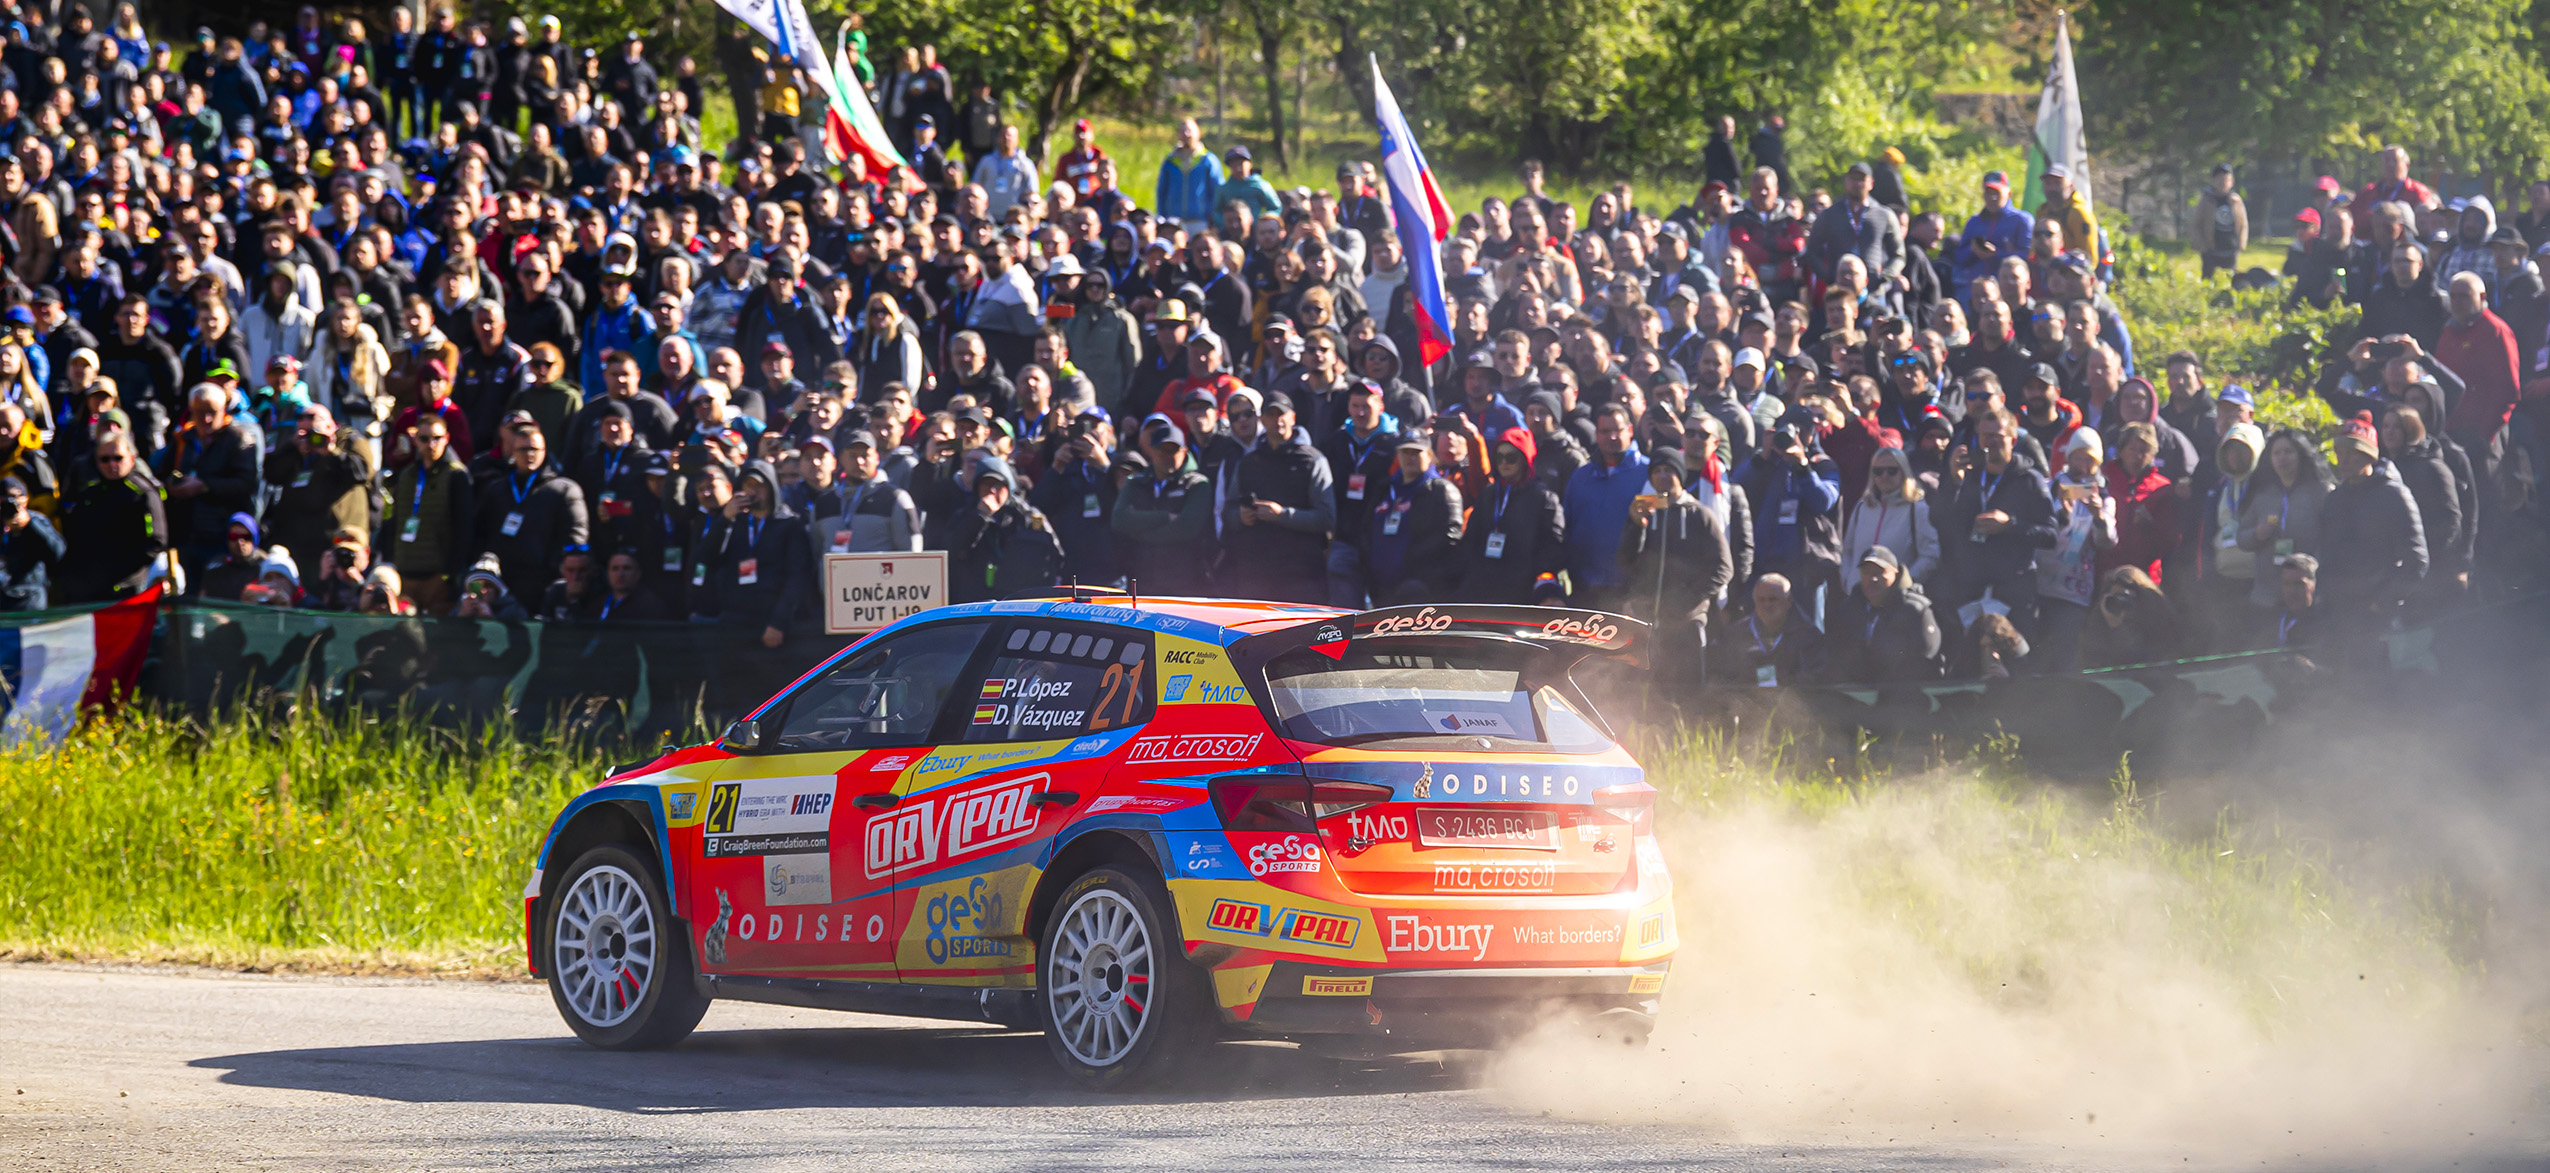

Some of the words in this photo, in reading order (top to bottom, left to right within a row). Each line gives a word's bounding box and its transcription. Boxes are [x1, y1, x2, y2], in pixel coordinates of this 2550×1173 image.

[842, 583, 931, 602] LONČAROV
[854, 606, 885, 621] PUT
[1164, 650, 1195, 664] RACC
[1002, 678, 1072, 701] P.López
[1088, 659, 1144, 730] 21
[993, 703, 1085, 731] D.Vázquez
[1462, 718, 1498, 727] JANAF
[918, 754, 973, 774] Ebury
[1442, 774, 1579, 796] ODISEO
[708, 785, 739, 832] 21
[1435, 816, 1447, 838] S
[1453, 817, 1497, 840] 2436
[1504, 818, 1536, 841] BCJ
[723, 837, 827, 854] CraigBreenFoundation.com
[1272, 862, 1318, 871] SPORTS
[738, 913, 884, 942] ODISEO
[953, 938, 1008, 955] SPORTS
[1387, 915, 1494, 961] Ebury
[1513, 926, 1555, 944] What
[1559, 924, 1621, 943] borders?
[1309, 979, 1367, 993] PIRELLI
